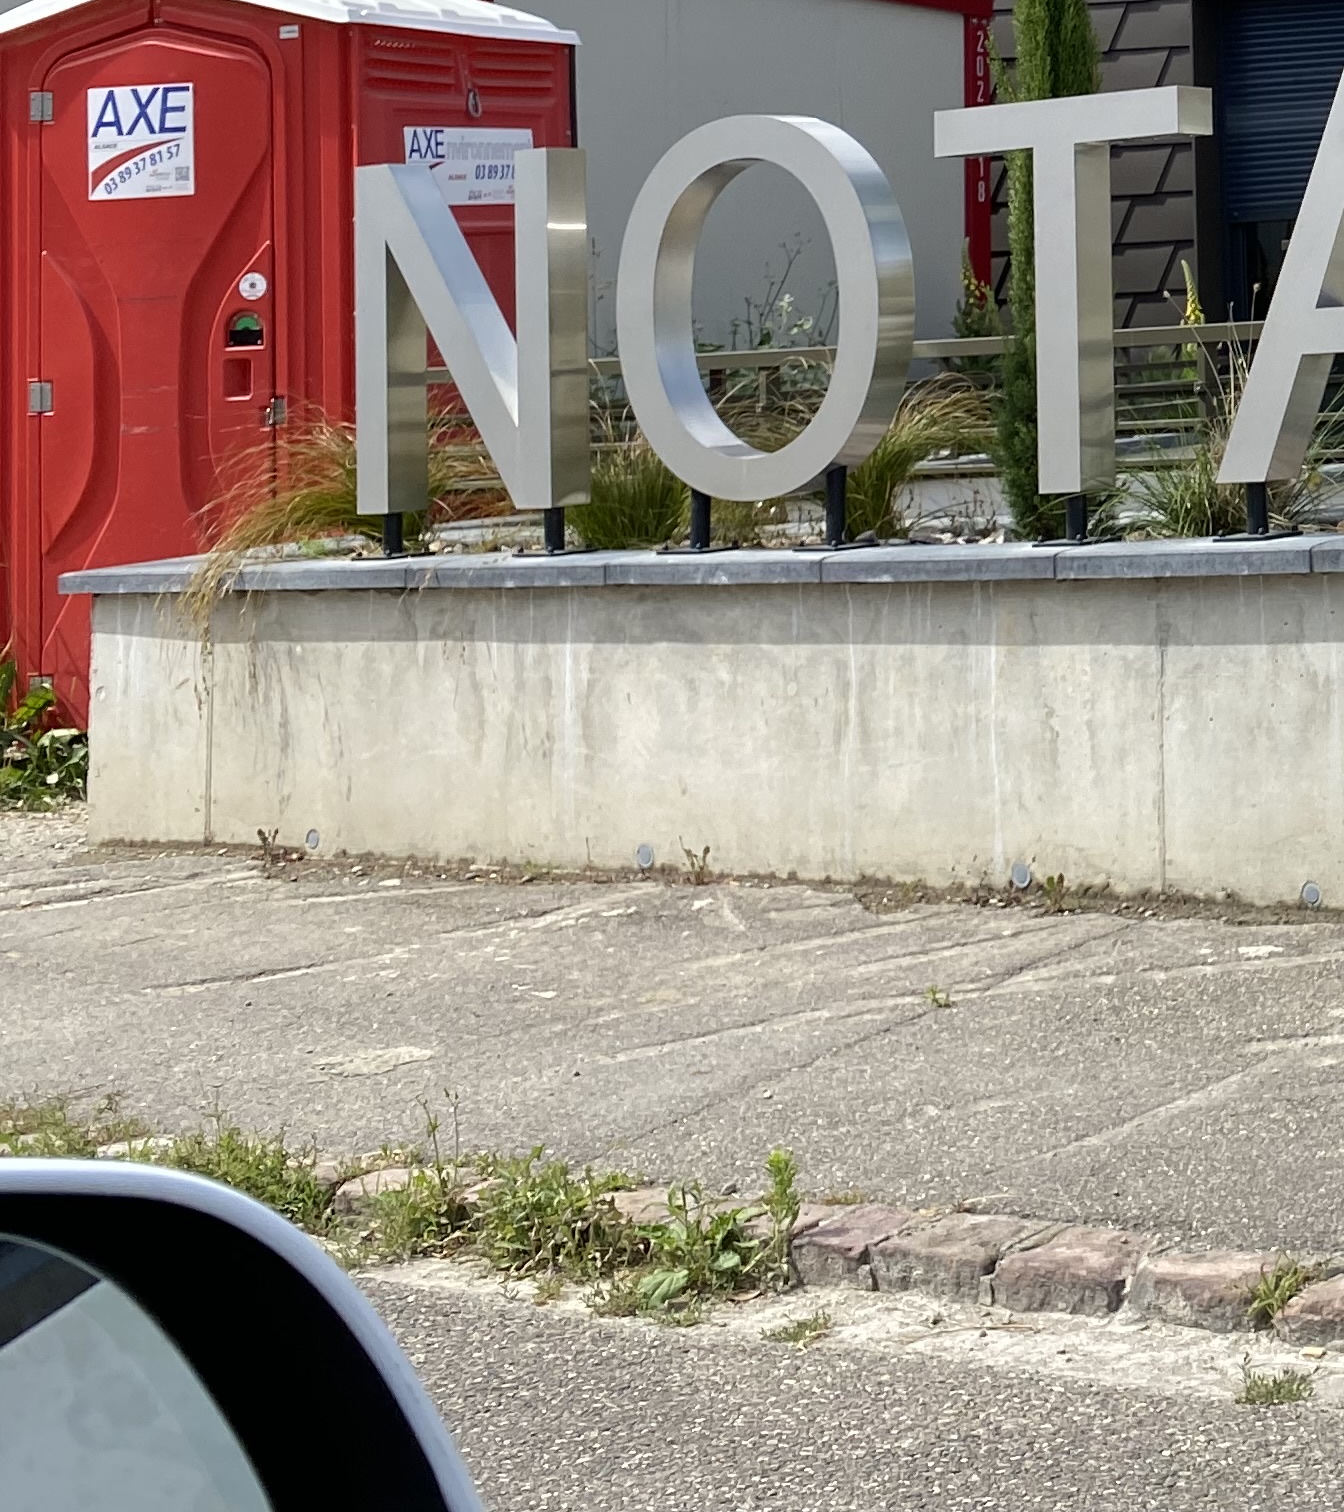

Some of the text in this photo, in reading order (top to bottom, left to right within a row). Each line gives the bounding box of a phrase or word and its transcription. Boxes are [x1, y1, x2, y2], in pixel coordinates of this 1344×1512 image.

[91, 86, 190, 138] AXE
[104, 177, 118, 195] 03
[118, 166, 132, 184] 89
[132, 157, 146, 175] 37
[149, 150, 163, 166] 81
[166, 143, 180, 160] 57
[475, 164, 486, 180] 03
[487, 164, 498, 180] 89
[499, 164, 510, 180] 37
